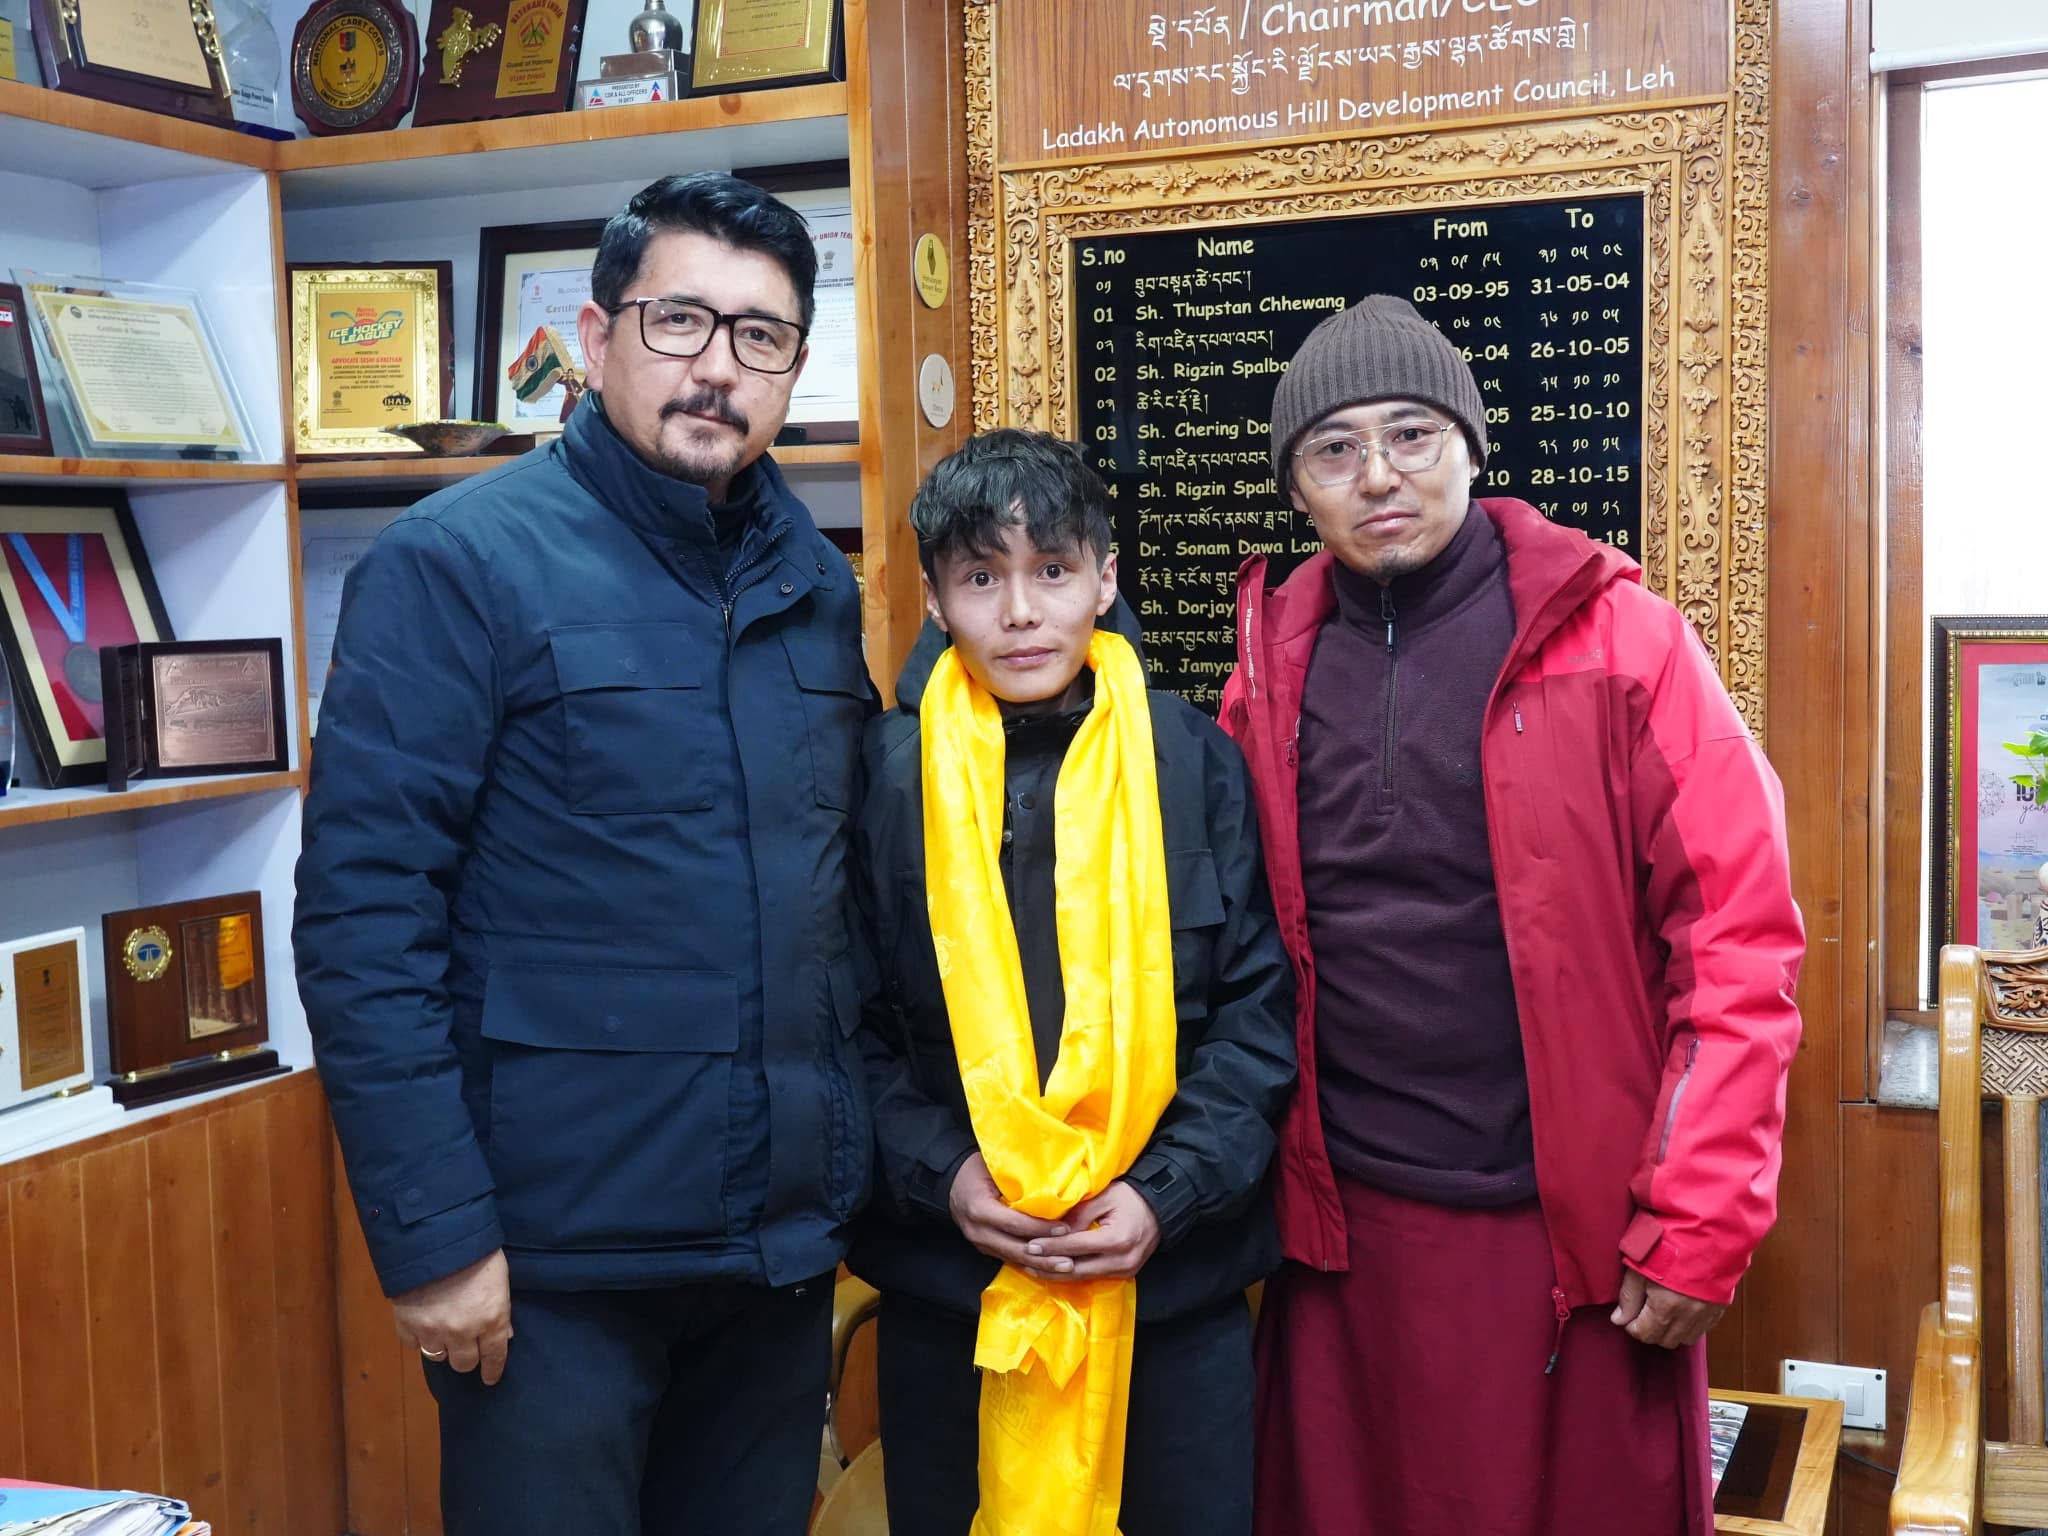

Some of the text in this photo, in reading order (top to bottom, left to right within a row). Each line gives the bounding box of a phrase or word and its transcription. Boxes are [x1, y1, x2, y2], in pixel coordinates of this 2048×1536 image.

[1042, 64, 1675, 150] Ladakh Autonomous Hill Development Council, Leh
[819, 231, 838, 240] UNION
[1081, 207, 1594, 266] S.no Name From To
[1093, 271, 1630, 323] 01 Sh. Thupstan Chhewang 03-09-95 31-05-04
[330, 319, 402, 338] ICE HOCKEY
[341, 329, 389, 345] LEAGUE
[1094, 366, 1116, 382] 02
[1136, 363, 1165, 380] Sh.
[1173, 362, 1225, 381] Rigzin
[1530, 337, 1630, 359] 26-10-05
[1095, 425, 1117, 440] 03
[1137, 423, 1166, 439] Sh.
[1174, 421, 1239, 439] Chering
[1530, 401, 1630, 422] 25-10-10
[1138, 483, 1166, 498] Sh.
[1176, 480, 1226, 500] Rigzin
[1530, 465, 1630, 485] 28-10-15
[1139, 542, 1166, 557] Dr.
[1175, 540, 1230, 555] Sonam
[1238, 539, 1283, 555] Dawa
[1140, 599, 1236, 618] Sh. Dorjay
